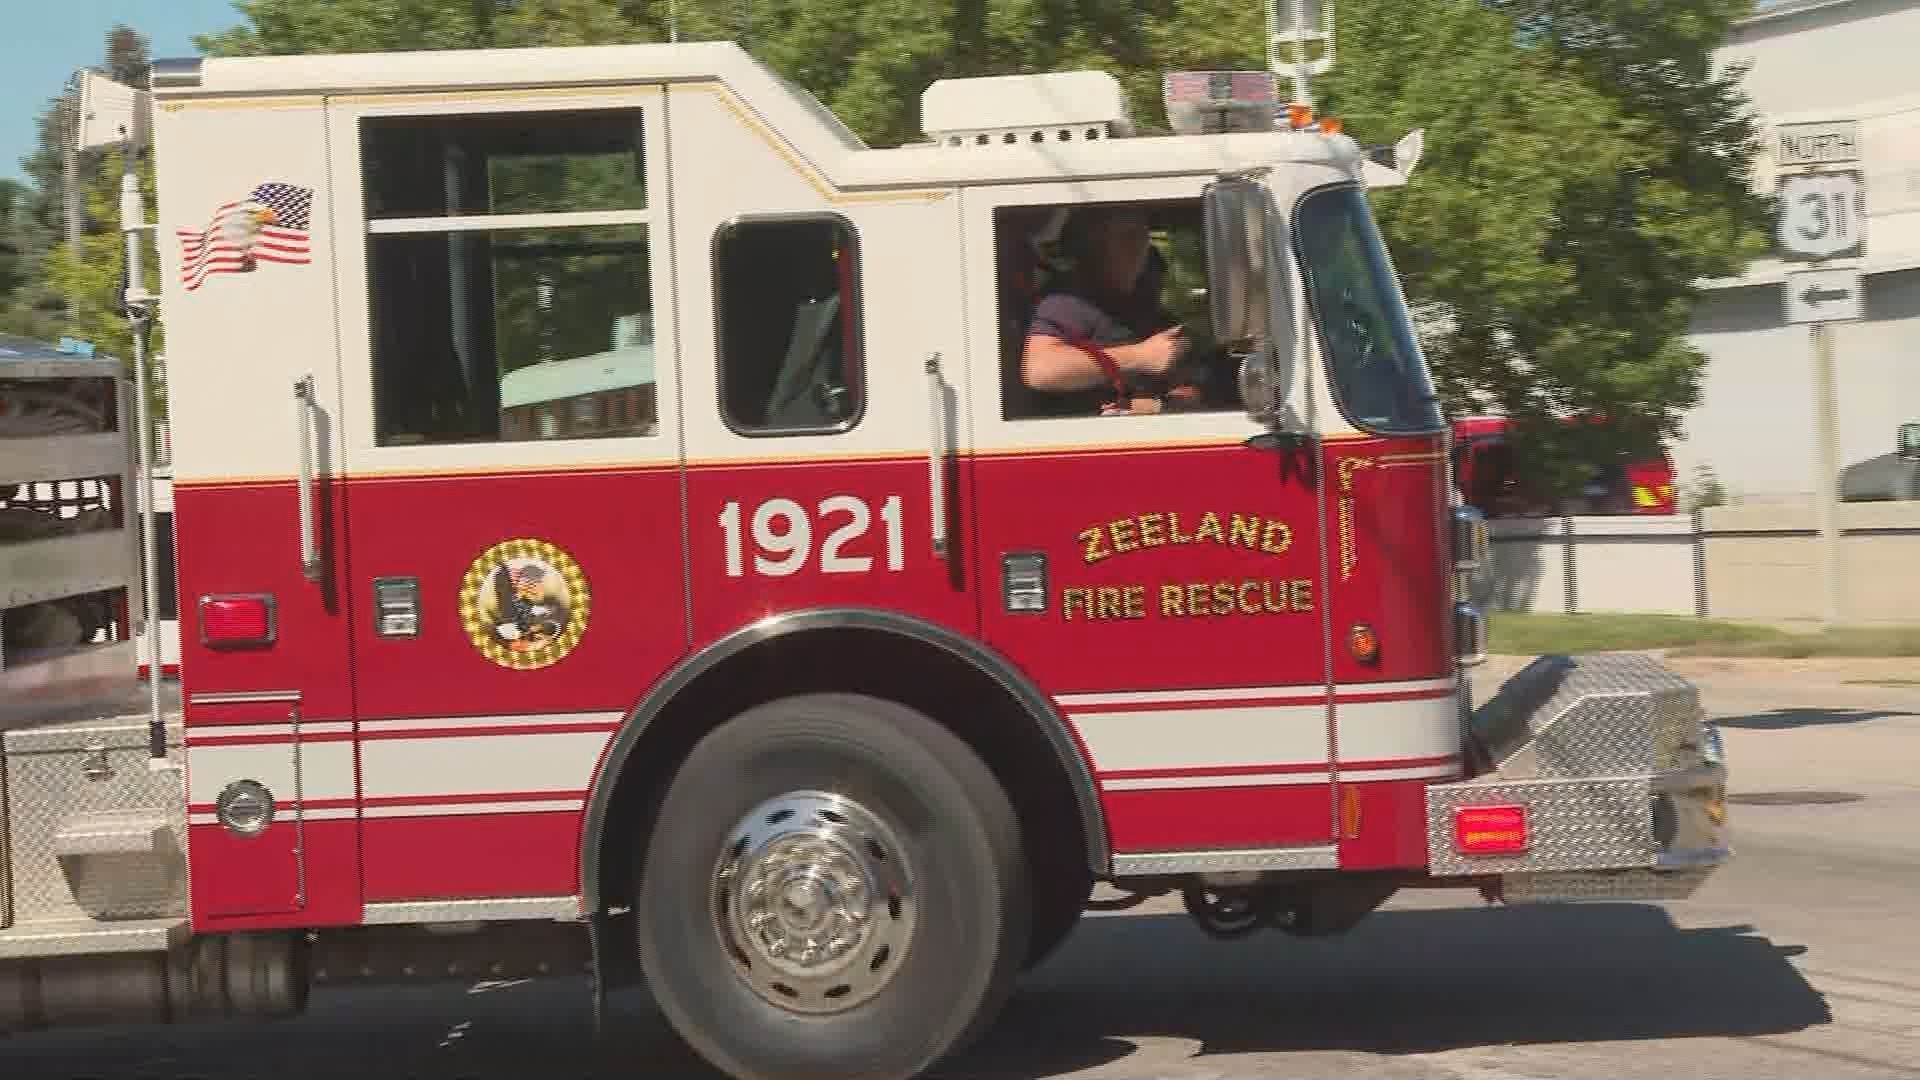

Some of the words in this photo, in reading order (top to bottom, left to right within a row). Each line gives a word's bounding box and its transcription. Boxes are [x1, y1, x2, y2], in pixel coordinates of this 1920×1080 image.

[1779, 133, 1857, 161] NORTH
[1797, 193, 1849, 240] 31
[718, 495, 905, 577] 1921
[1077, 511, 1294, 565] ZEELAND
[1063, 585, 1146, 620] FIRE
[1160, 577, 1315, 617] RESCUE
